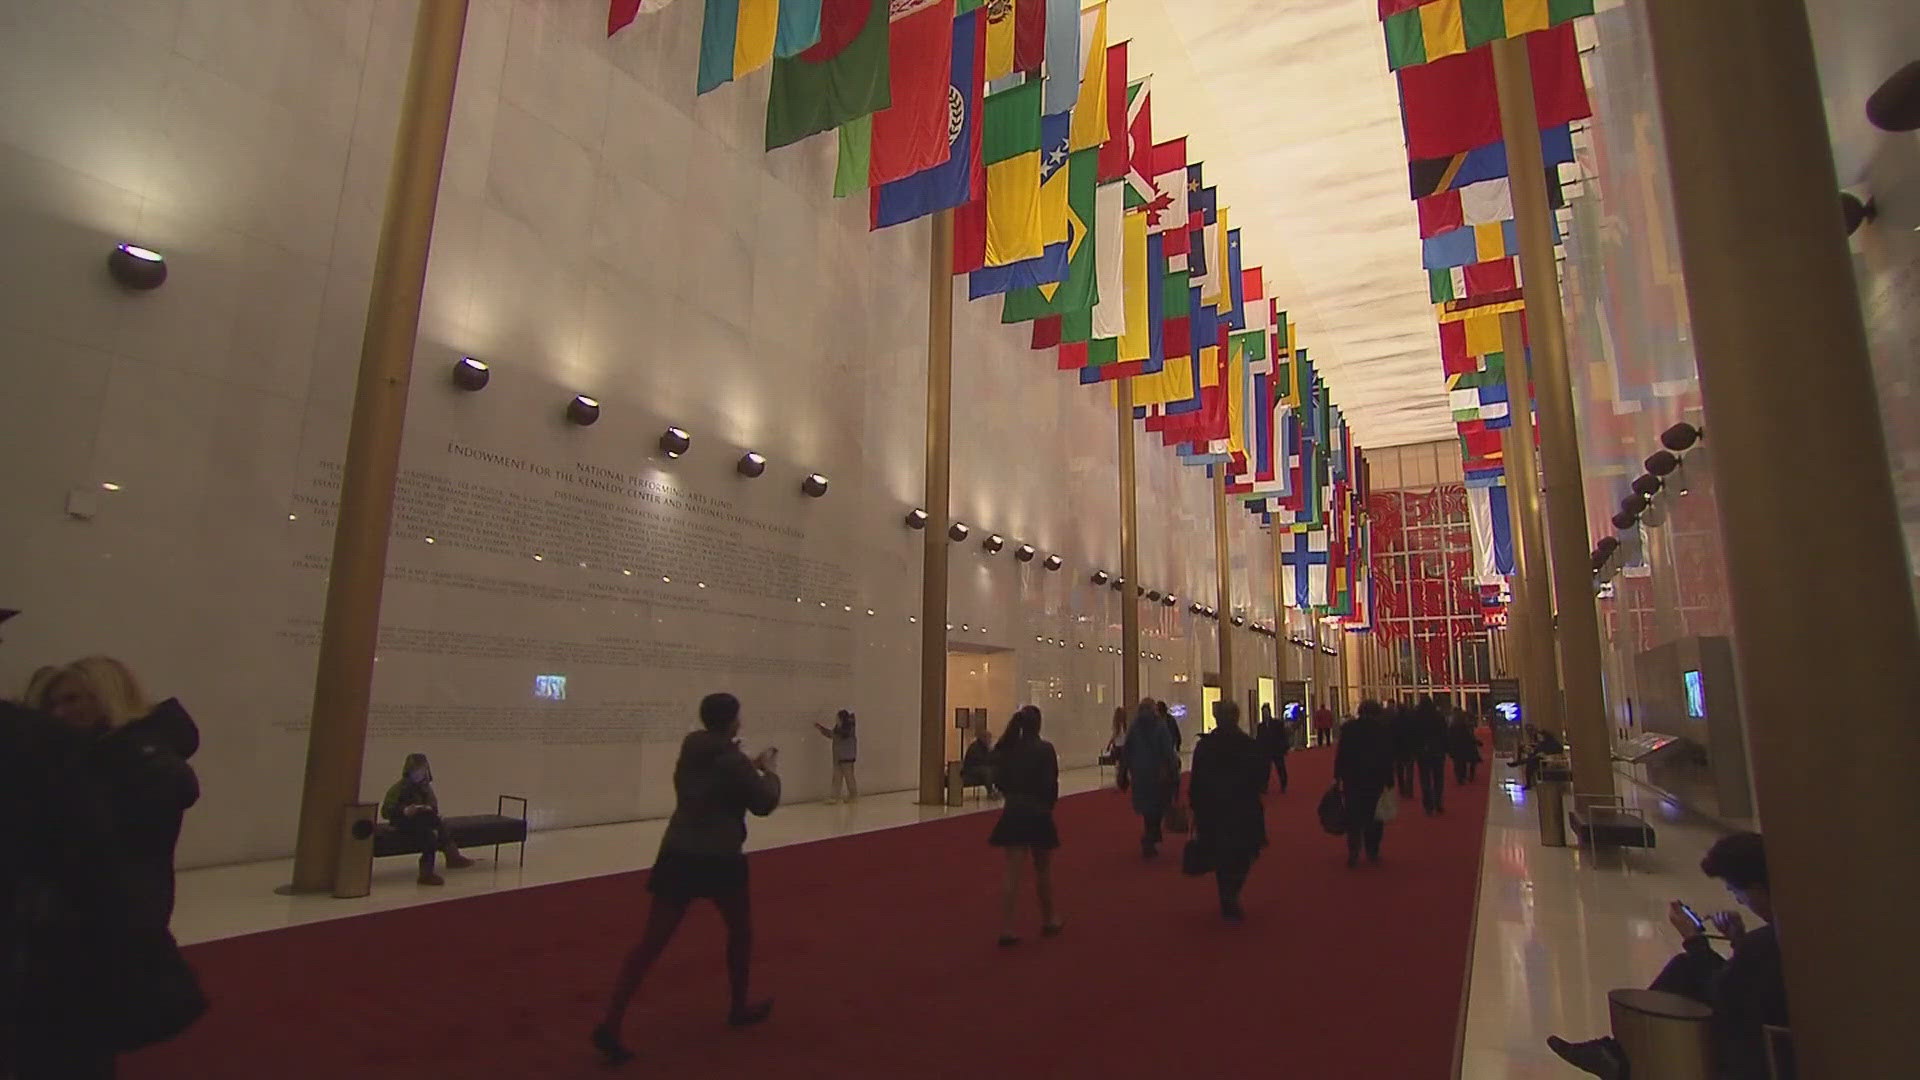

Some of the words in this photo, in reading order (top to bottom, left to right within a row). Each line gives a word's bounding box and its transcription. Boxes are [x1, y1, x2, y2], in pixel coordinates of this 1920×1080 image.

[447, 442, 526, 471] ENDOWMENT
[529, 463, 552, 478] FOR
[555, 470, 574, 483] THE
[578, 475, 624, 495] KENNEDY
[627, 489, 661, 504] CENTER
[663, 496, 682, 509] AND
[684, 502, 724, 520] NATIONAL
[576, 462, 624, 483] NATIONAL
[629, 475, 684, 497] PERFORMING
[688, 491, 707, 503] ARTS
[710, 498, 733, 510] FUND
